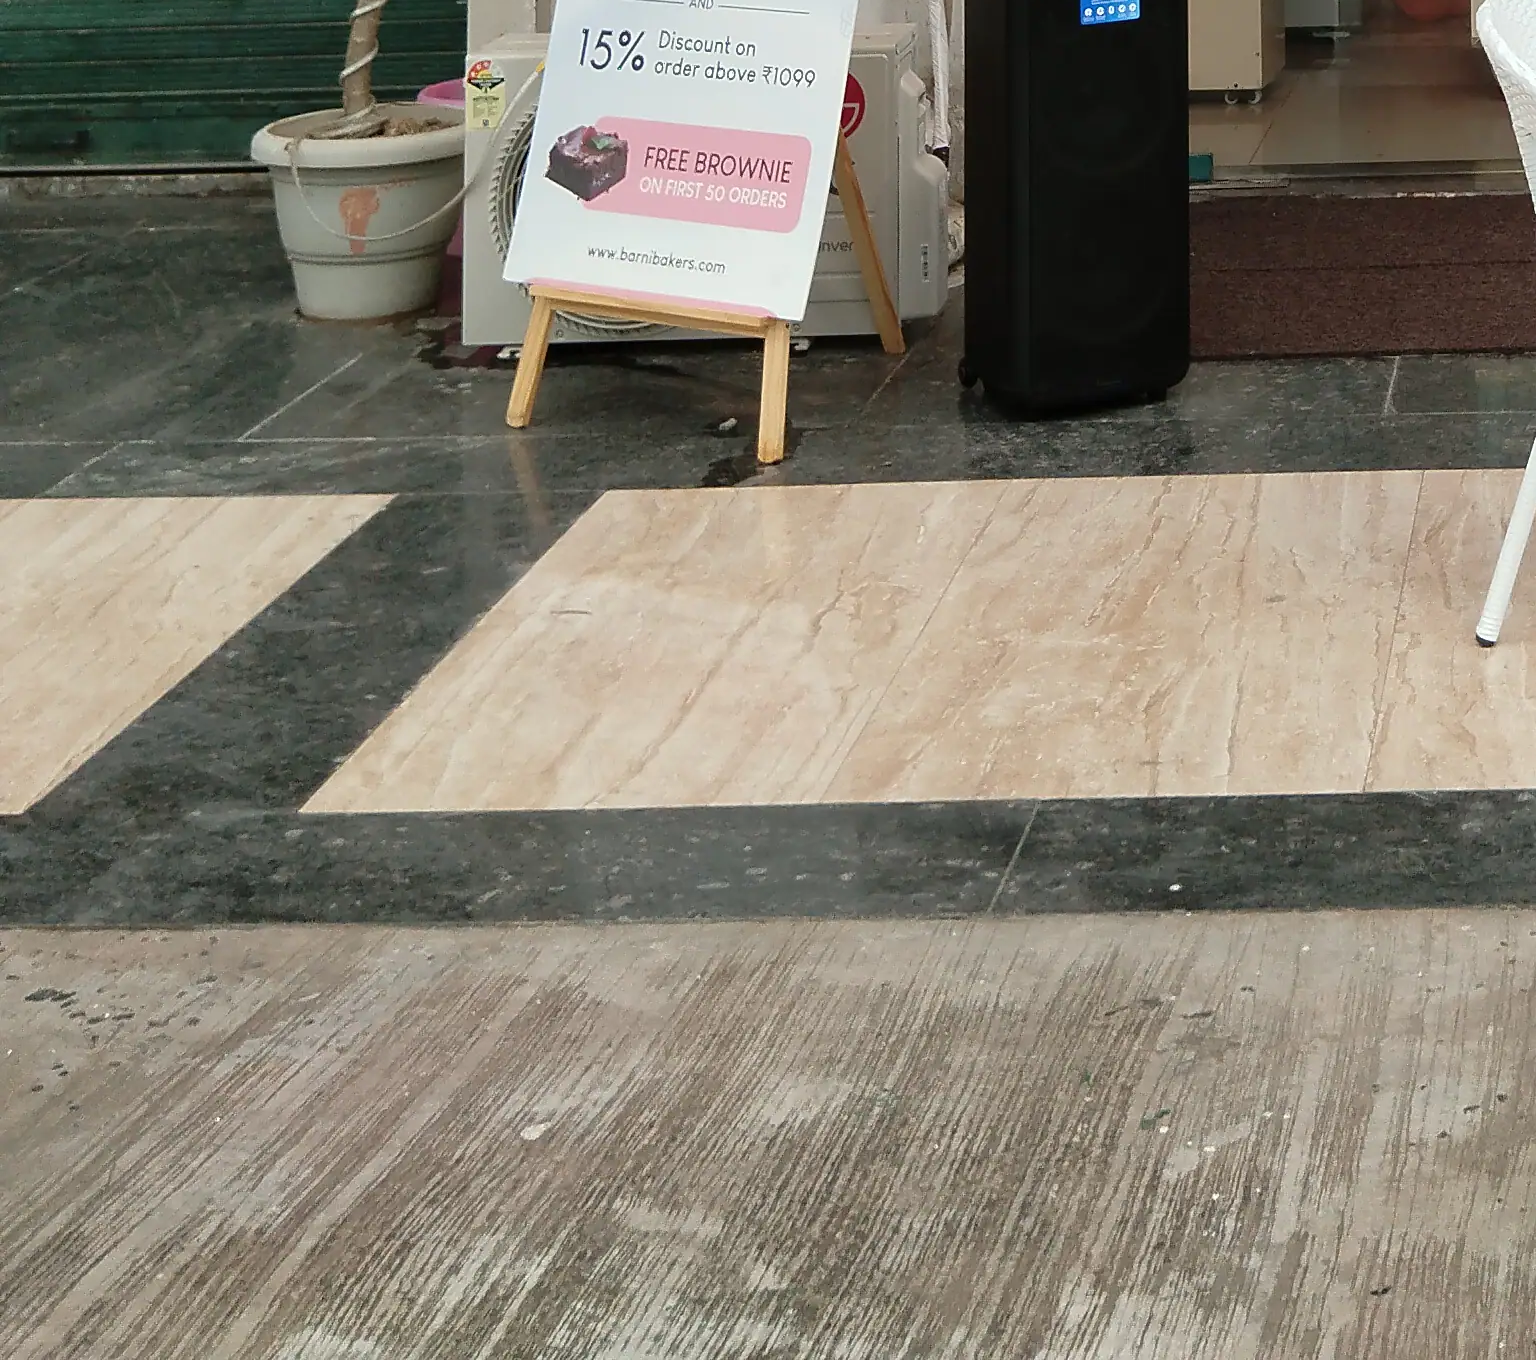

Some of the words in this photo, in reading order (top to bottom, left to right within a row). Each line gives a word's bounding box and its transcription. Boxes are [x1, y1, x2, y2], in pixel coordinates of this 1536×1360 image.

[579, 28, 645, 71] 15%
[659, 30, 731, 55] Discount
[736, 43, 756, 57] on
[654, 58, 700, 77] order
[705, 62, 756, 83] above
[762, 65, 816, 88] ₹1099
[644, 146, 690, 172] FREE
[694, 151, 793, 183] BROWNIE
[639, 177, 663, 195] ON
[665, 179, 703, 199] FIRST
[705, 186, 725, 202] 50
[728, 187, 788, 209] ORDERS
[588, 246, 726, 274] www.barnibakers.com
[818, 239, 855, 252] inver
